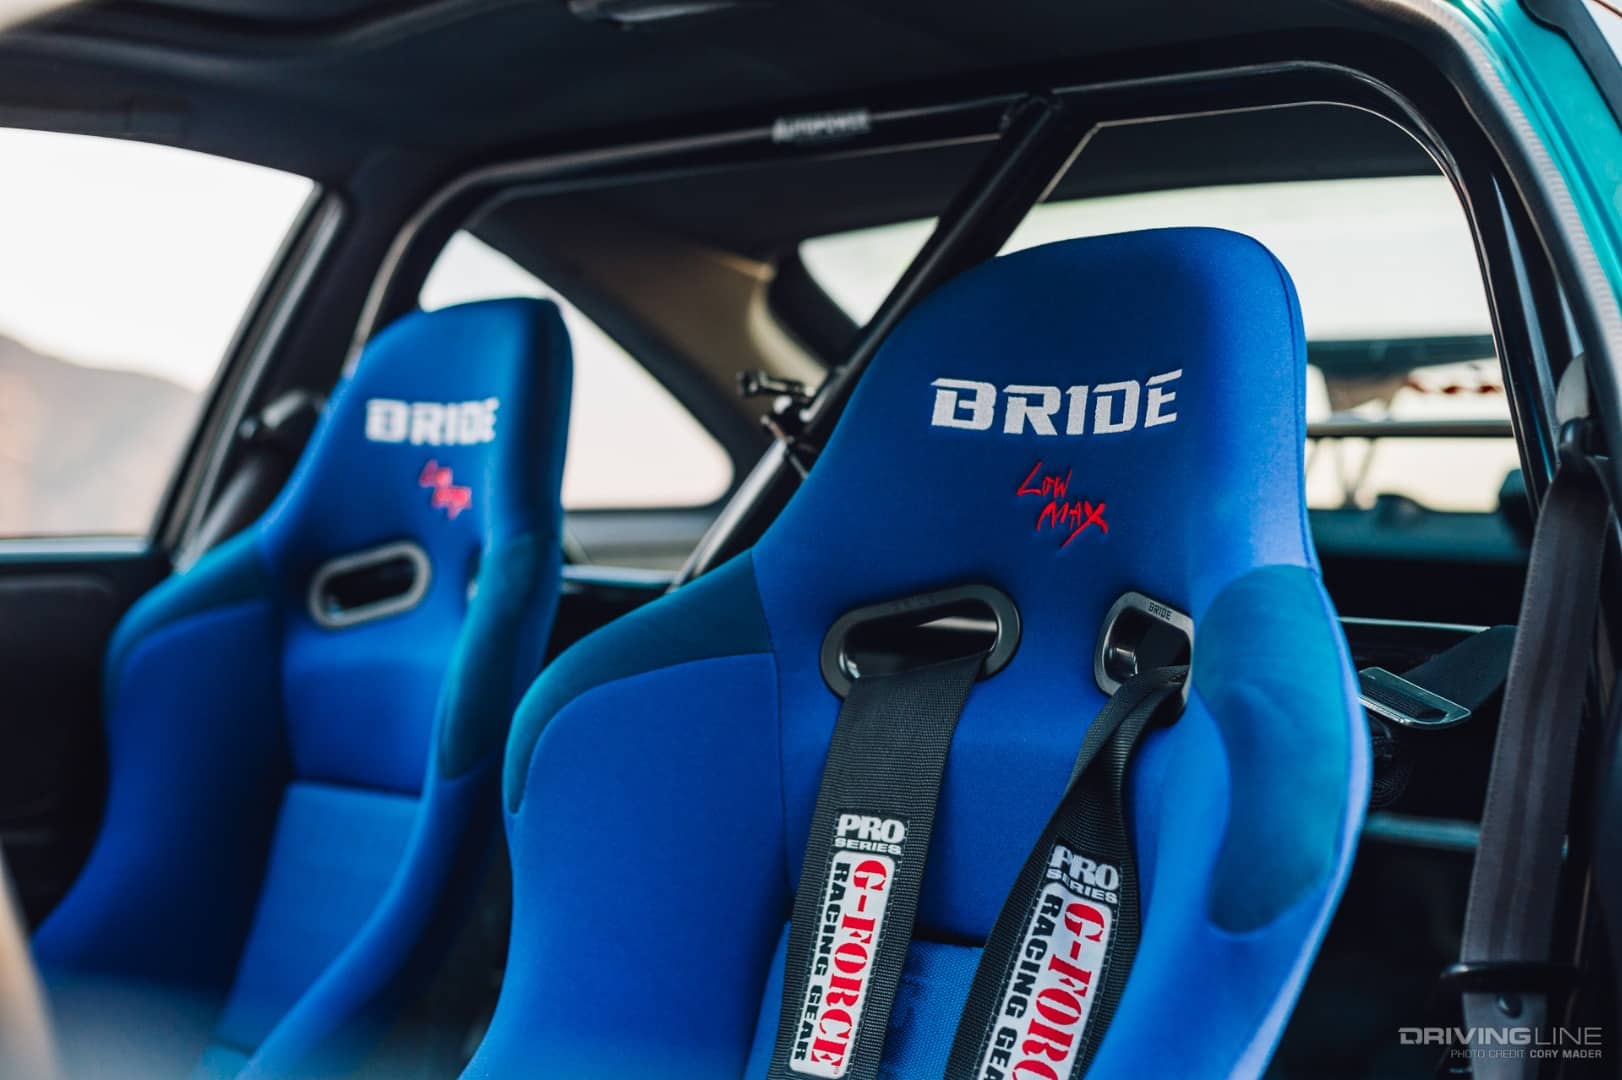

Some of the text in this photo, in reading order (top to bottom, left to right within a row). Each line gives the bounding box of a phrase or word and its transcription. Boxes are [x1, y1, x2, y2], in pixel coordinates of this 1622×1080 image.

[365, 397, 499, 446] BRIDE
[930, 368, 1183, 436] BRIDE
[1036, 500, 1108, 549] MAX
[1148, 602, 1172, 621] BRIDE
[834, 838, 902, 854] SERIES
[836, 814, 905, 844] PRO
[1046, 868, 1119, 905] SERIES
[1050, 845, 1120, 891] PRO
[794, 862, 851, 1062] RACING GEAR
[810, 859, 888, 1069] G-FORCE
[1005, 893, 1064, 1020] RACING
